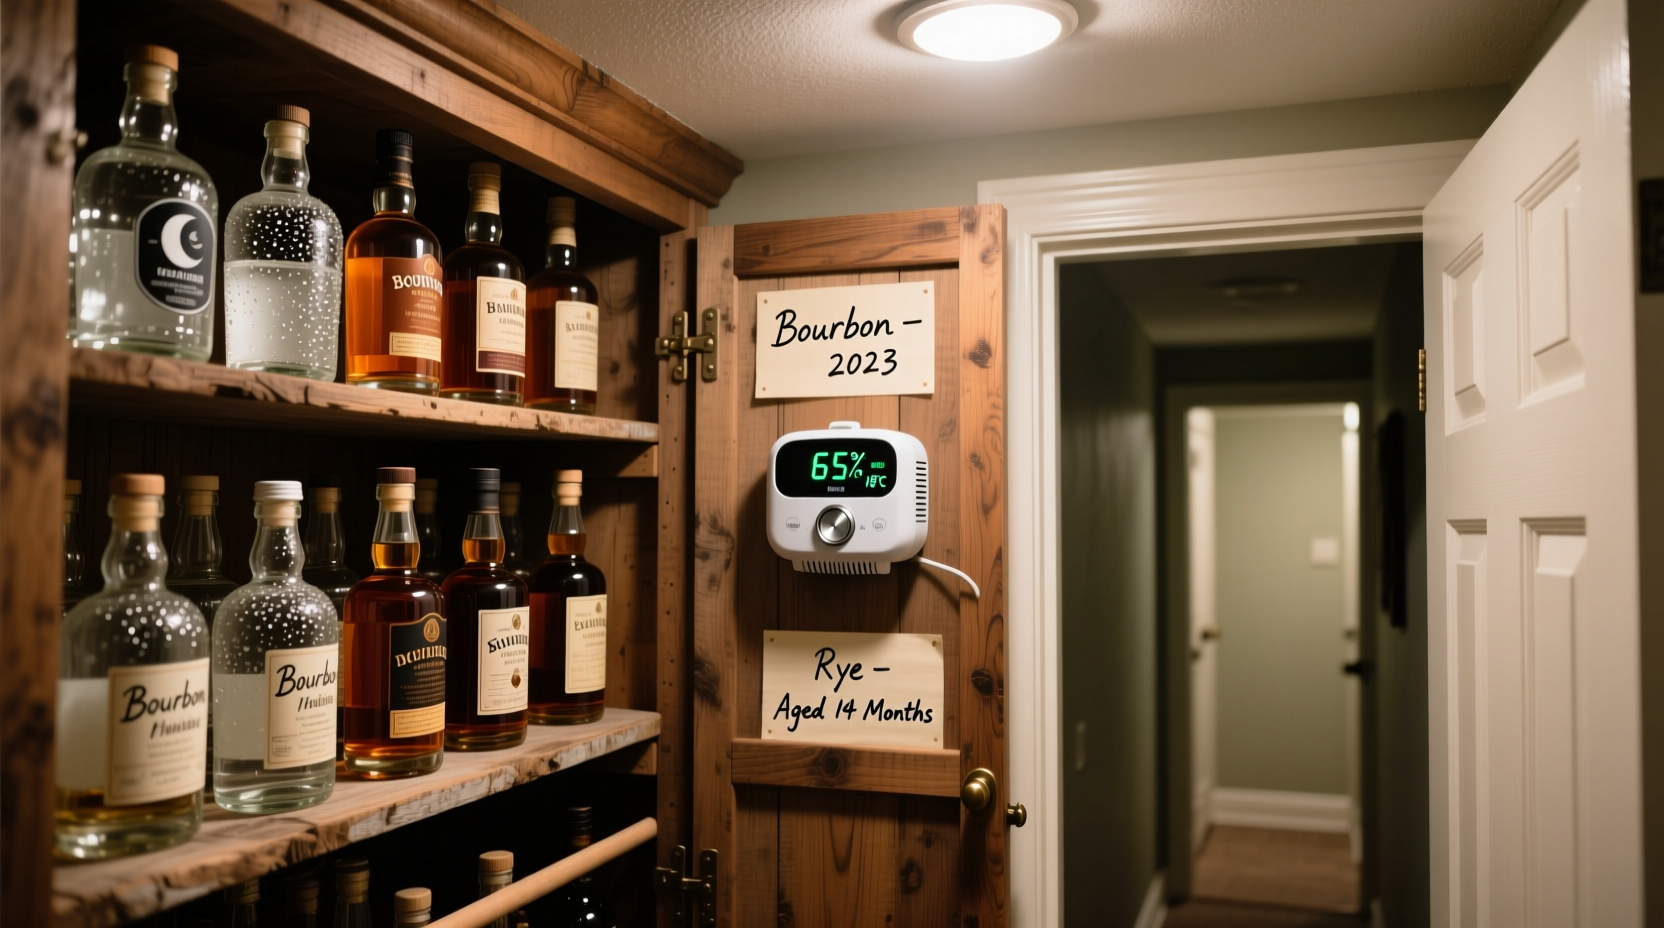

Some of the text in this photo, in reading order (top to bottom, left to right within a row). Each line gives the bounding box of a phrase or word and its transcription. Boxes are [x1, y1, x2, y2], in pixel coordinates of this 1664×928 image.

[770, 305, 894, 348] Bourbon
[827, 348, 898, 378] 2023
[811, 451, 866, 481] 65%
[814, 646, 864, 693] Rye
[119, 679, 206, 724] Bourbon
[772, 692, 934, 733] Aged 14 Months
